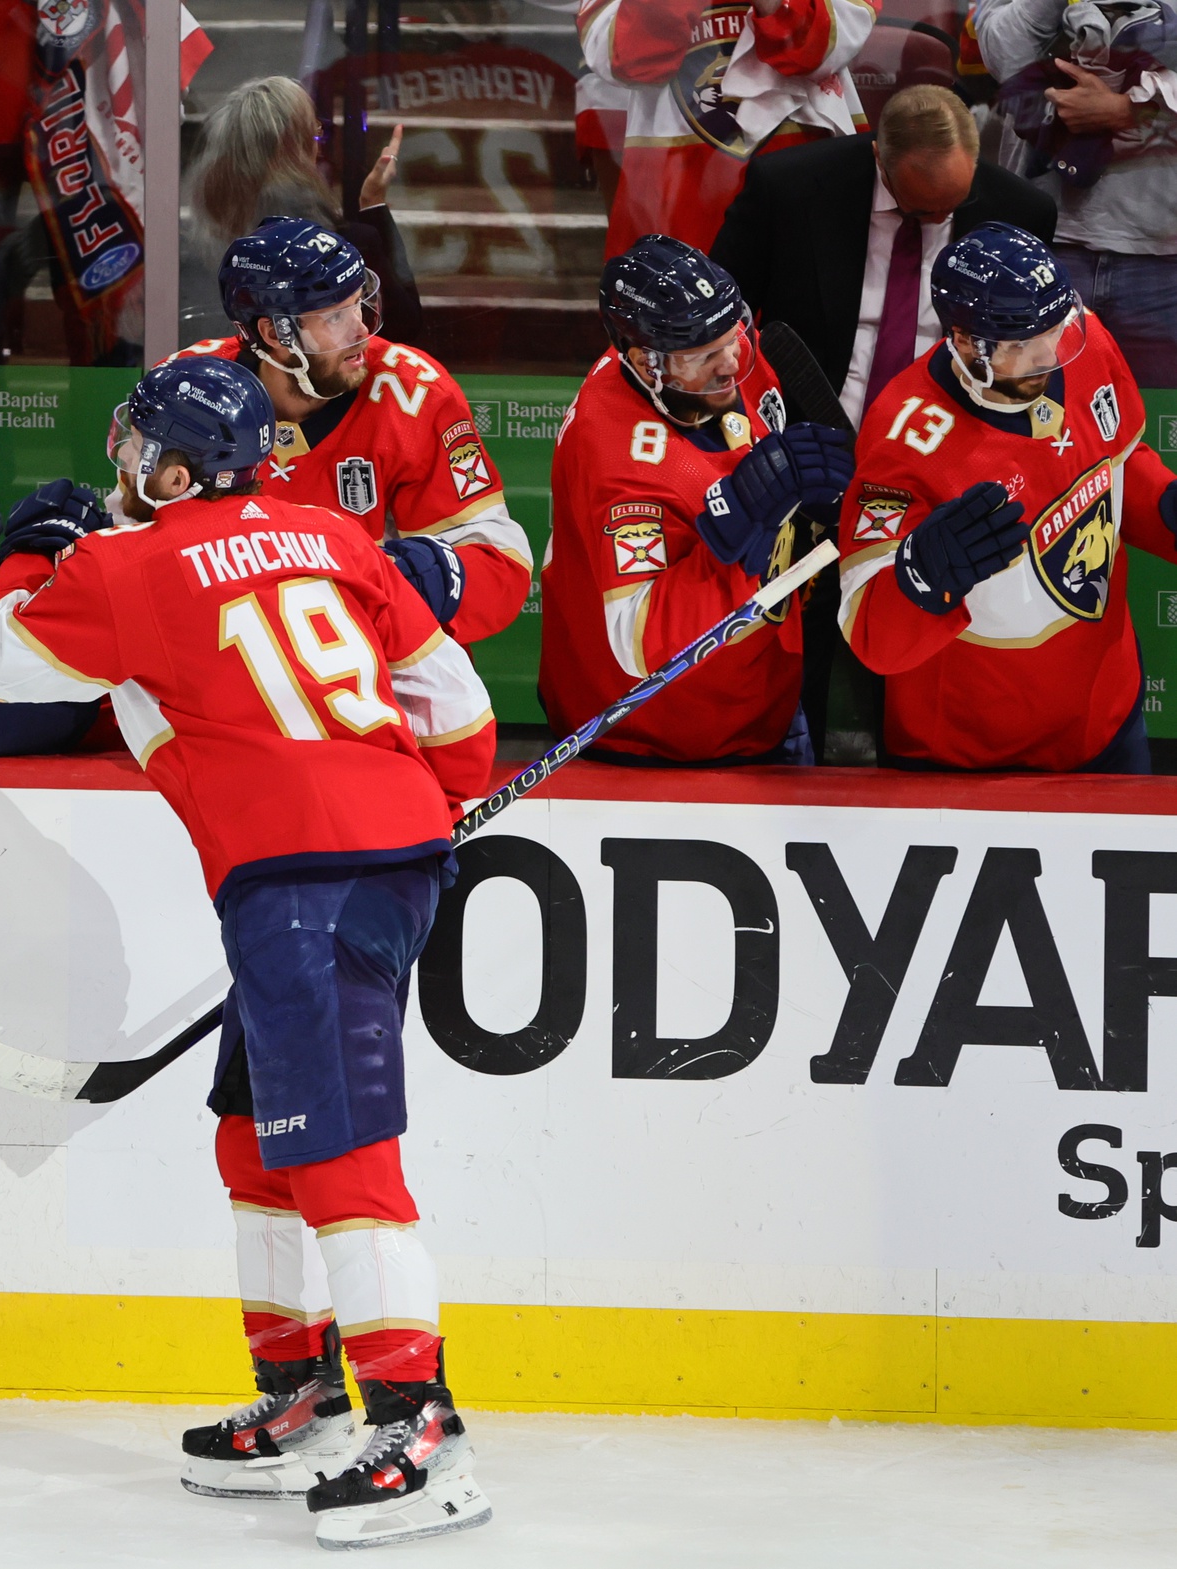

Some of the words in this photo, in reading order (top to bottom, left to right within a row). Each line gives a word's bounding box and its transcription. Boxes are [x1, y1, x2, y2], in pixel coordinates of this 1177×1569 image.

[691, 15, 746, 43] ANTH
[237, 261, 272, 272] LAUDERDALE
[336, 259, 360, 284] CCM
[954, 264, 988, 284] LAUDERDALE
[1029, 264, 1055, 288] 13
[622, 289, 657, 309] LAUDERDALE
[695, 277, 715, 299] 8
[1038, 293, 1067, 317] CCM
[190, 385, 207, 397] VISIT
[368, 344, 441, 418] 23
[187, 391, 226, 416] LAUDERDALE
[506, 401, 569, 422] Baptist
[258, 424, 270, 449] 19
[885, 396, 955, 457] 13
[630, 419, 669, 465] 8
[868, 485, 905, 498] FLORIDA
[239, 509, 271, 520] adidas
[616, 504, 657, 516] FLORIDA
[1041, 468, 1110, 546] PANTHERS
[180, 531, 341, 588] TKACHUK
[218, 576, 402, 741] 19
[245, 1421, 289, 1448] BER
